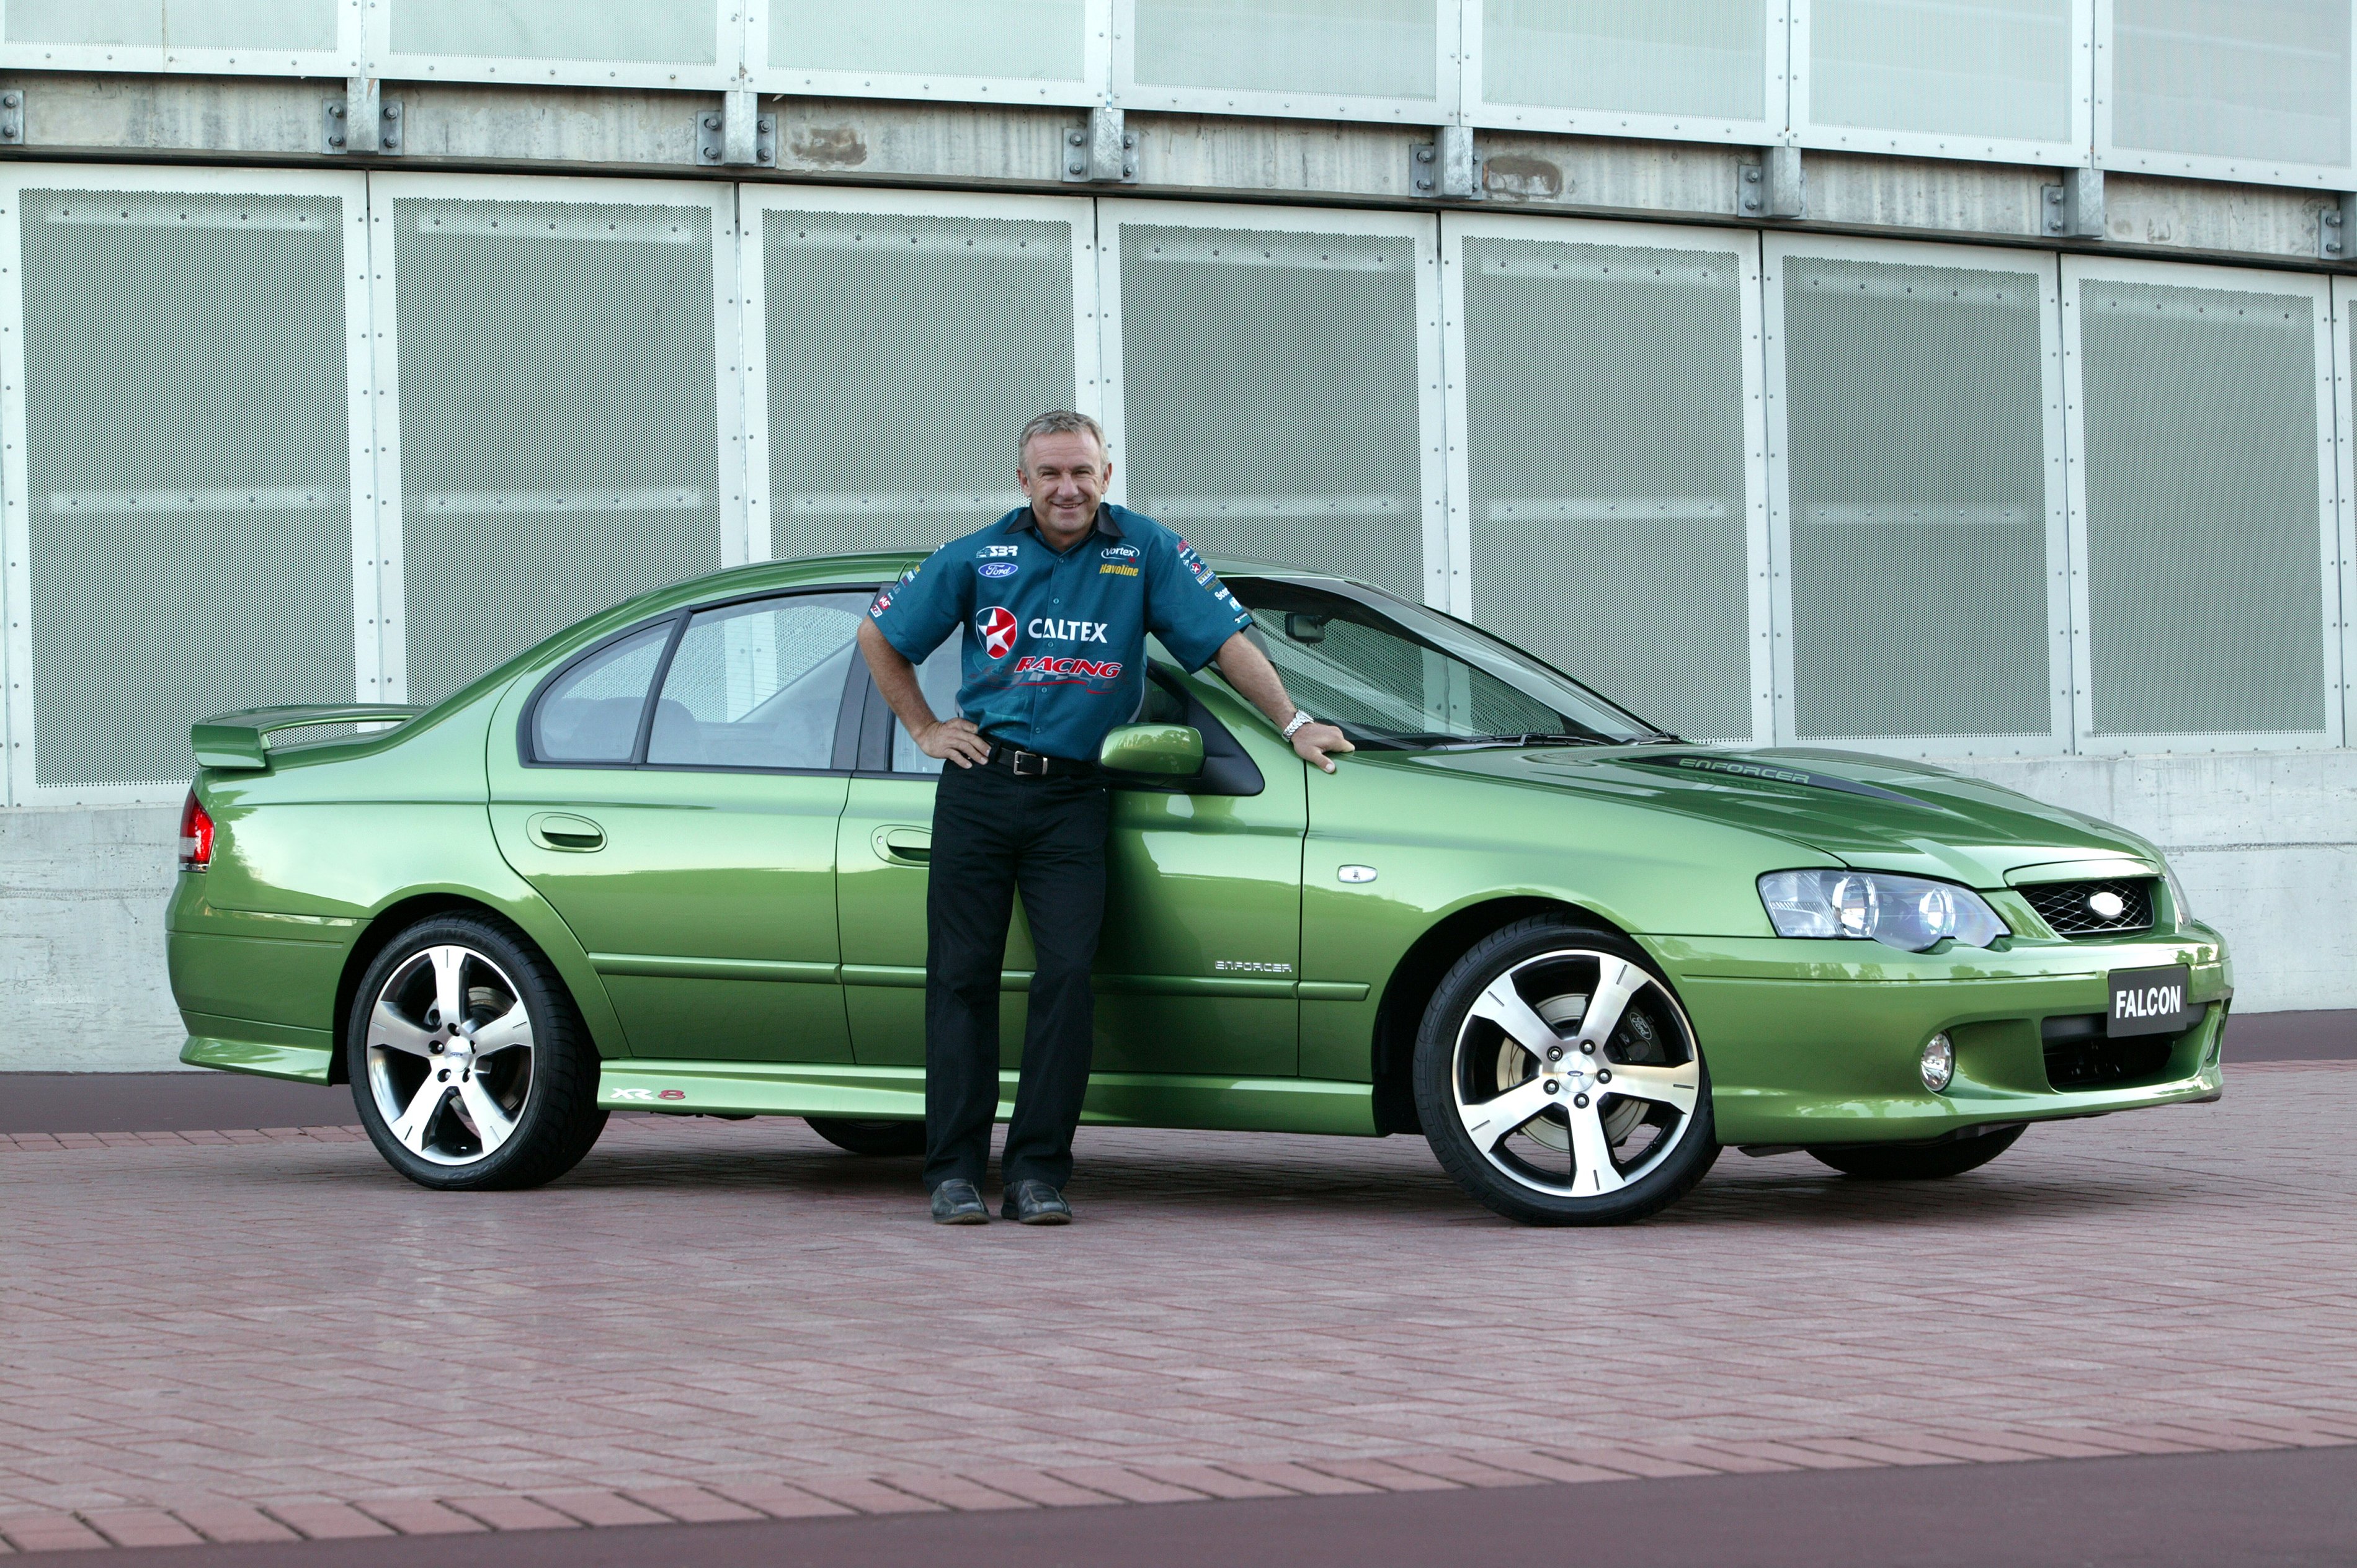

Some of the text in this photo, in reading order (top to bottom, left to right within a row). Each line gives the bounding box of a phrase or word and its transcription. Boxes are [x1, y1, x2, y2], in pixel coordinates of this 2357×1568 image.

[1104, 547, 1135, 557] Vortex
[1099, 563, 1139, 577] Havoline
[1028, 618, 1108, 644] CALTEX
[1014, 656, 1123, 679] RACING
[1678, 758, 1810, 784] ENFORCER
[1215, 960, 1293, 973] ENFORCER
[2115, 985, 2181, 1019] FALCON
